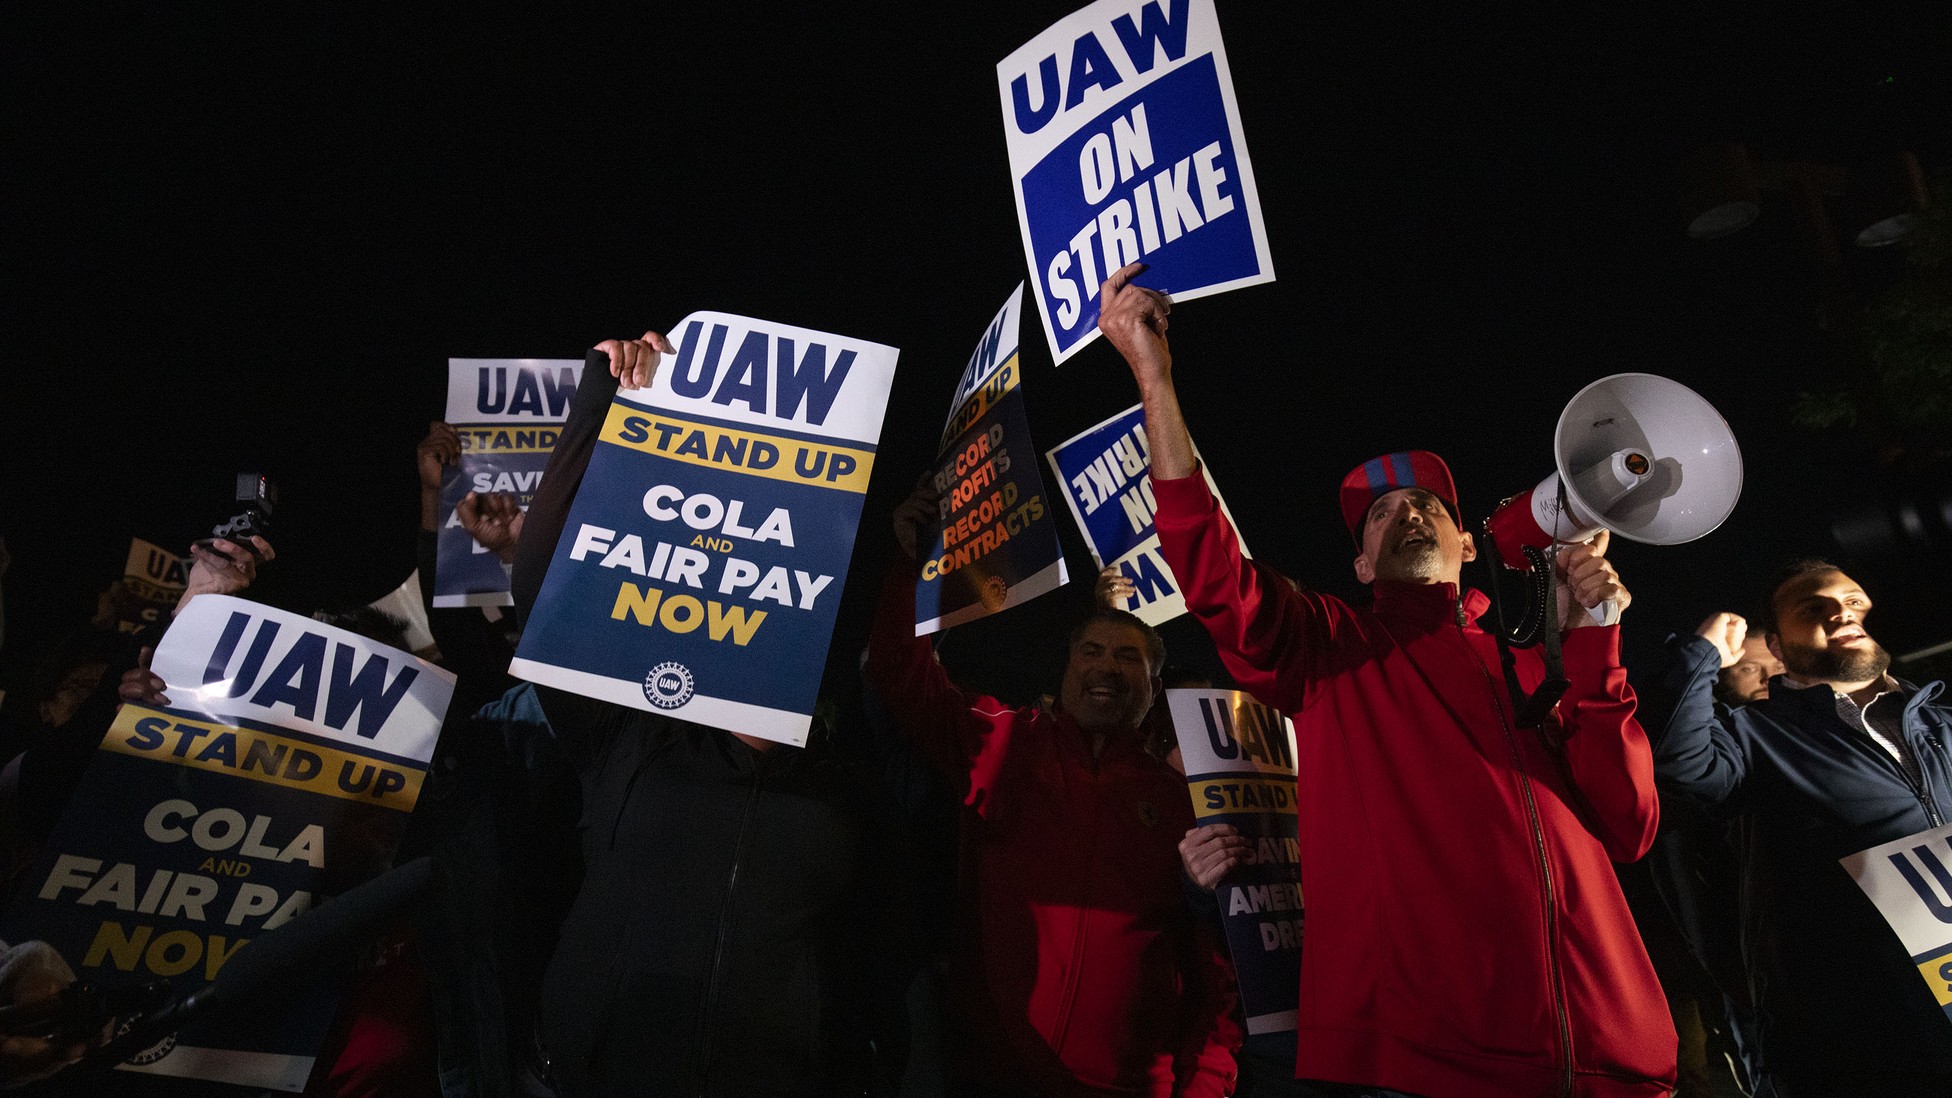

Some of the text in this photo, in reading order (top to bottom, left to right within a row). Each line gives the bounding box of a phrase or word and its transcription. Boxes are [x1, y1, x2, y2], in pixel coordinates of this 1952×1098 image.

[1011, 0, 1189, 134] UAW
[1079, 102, 1154, 205] ON
[1048, 140, 1235, 330] STRIKE
[477, 367, 579, 416] UAW
[670, 321, 857, 426] UAW
[986, 366, 1013, 403] UP
[618, 415, 857, 482] STAND UP
[934, 424, 1004, 494] RECORD
[643, 484, 796, 548] COLA
[938, 448, 1011, 520] PROFITS
[943, 481, 1018, 551] RECORD
[569, 523, 834, 611] FAIR PAY
[690, 534, 734, 554] AND
[921, 495, 1044, 581] CONTRACTS
[611, 581, 768, 647] NOW
[202, 611, 420, 739] UAW
[659, 677, 680, 690] UAW
[126, 717, 406, 799] STAND UP
[1199, 697, 1292, 769] UAW
[1204, 784, 1287, 809] STAND
[144, 799, 325, 868] COLA
[199, 857, 251, 878] AND
[38, 853, 317, 931] FAIR PA
